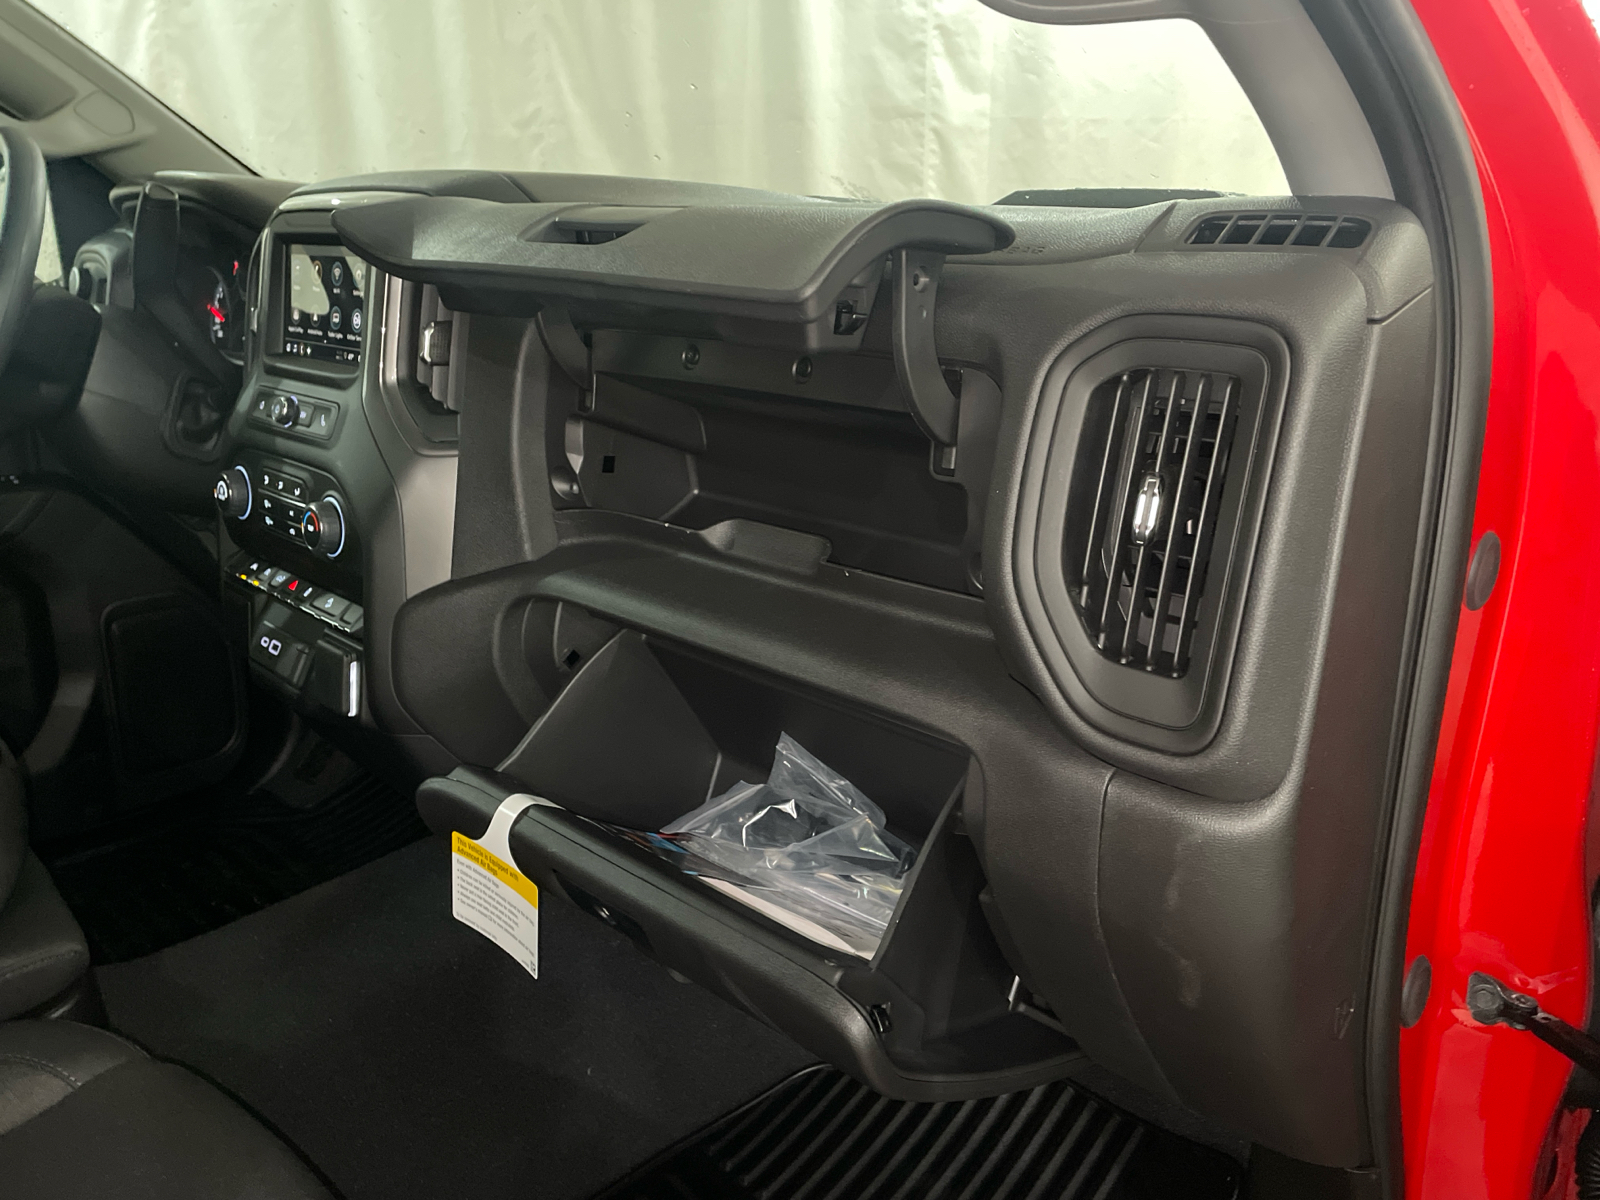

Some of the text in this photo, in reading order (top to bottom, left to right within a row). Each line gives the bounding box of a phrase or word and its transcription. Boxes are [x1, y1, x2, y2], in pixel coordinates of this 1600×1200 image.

[457, 837, 519, 882] This Vehicle is Equipped with
[457, 846, 479, 864] Advanced
[487, 862, 497, 876] Bags
